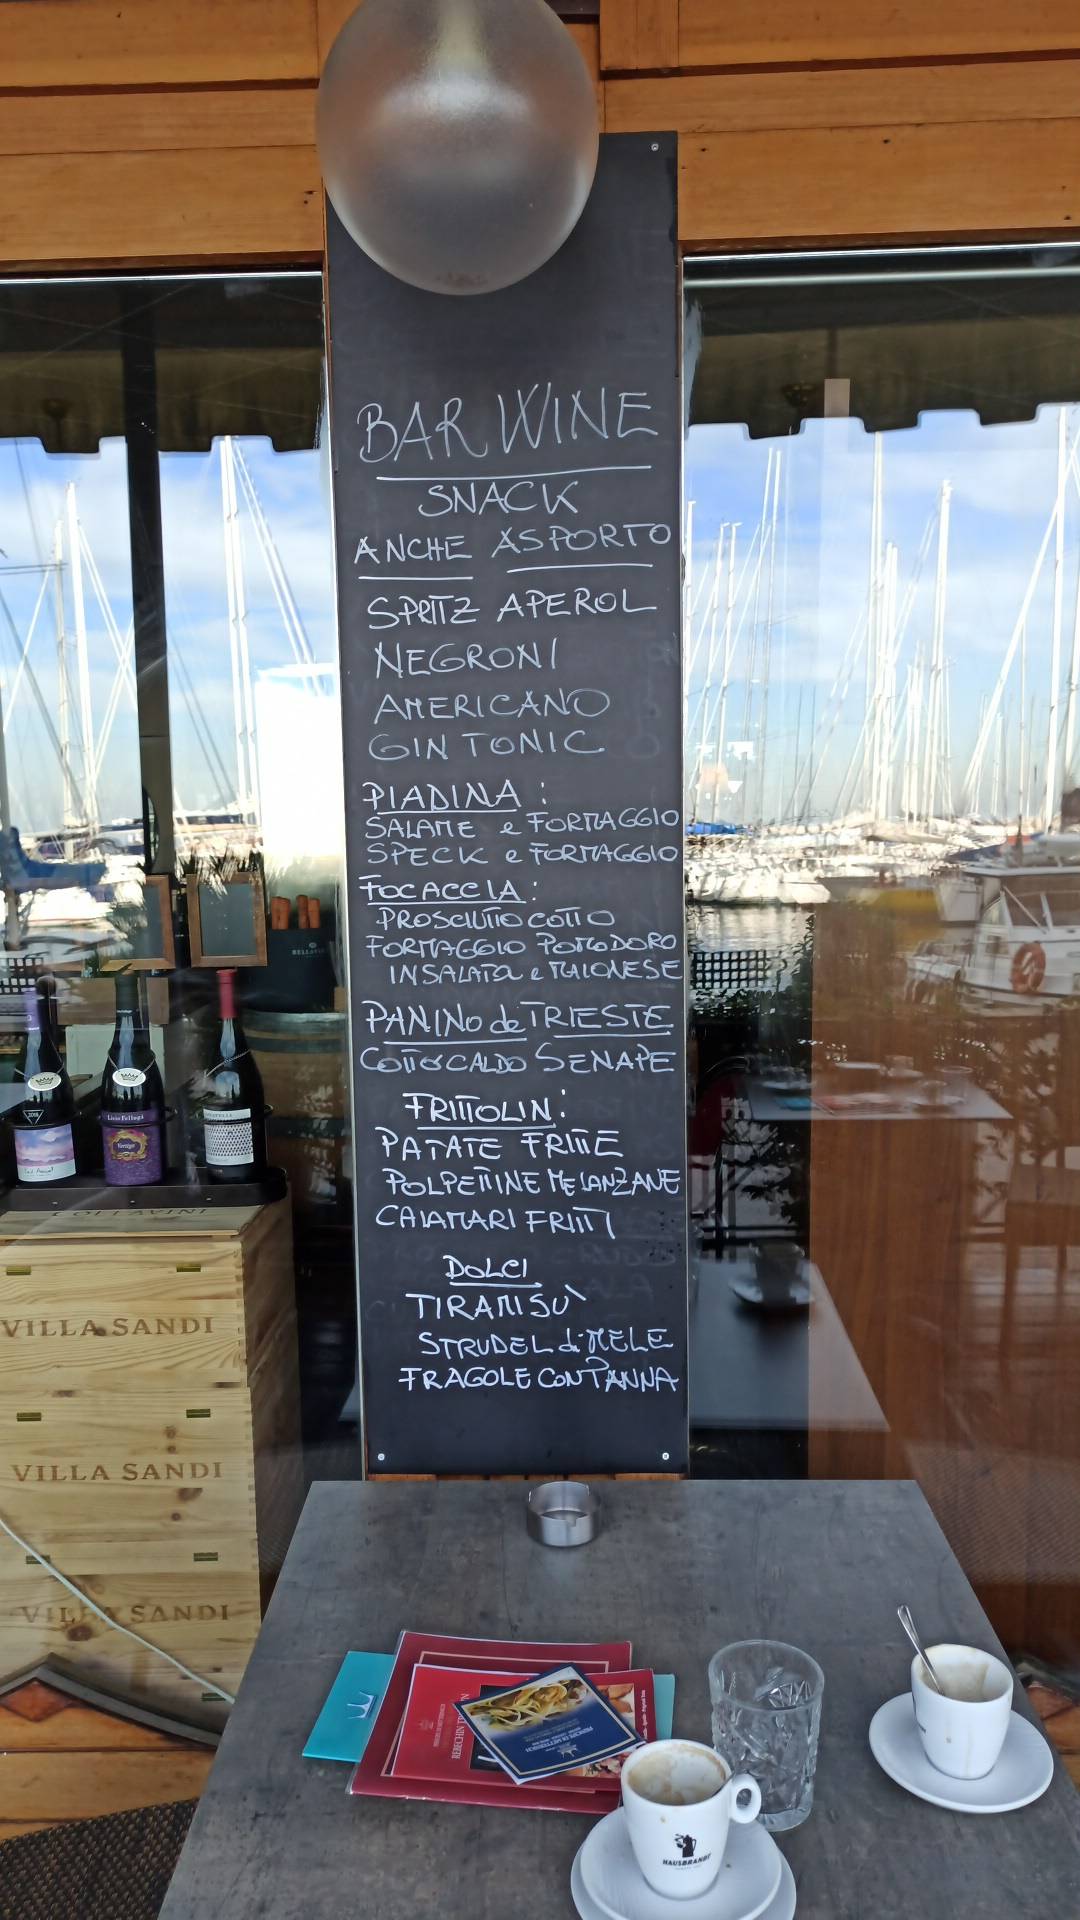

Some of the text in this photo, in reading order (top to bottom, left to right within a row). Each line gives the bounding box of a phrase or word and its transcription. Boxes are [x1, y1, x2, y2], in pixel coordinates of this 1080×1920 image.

[358, 382, 658, 463] BAR WINE
[418, 481, 579, 517] SNACK
[354, 523, 671, 564] ANCHE ASPORTO
[367, 587, 657, 630] SPRITZ APEROL
[374, 637, 558, 679] NEGRONI
[373, 687, 610, 724] AMERICANO
[368, 728, 606, 761] GIN TONIC
[364, 807, 680, 839] SALAME e FORMAGGIO
[367, 841, 678, 867] SPECK e FORMAGGIO
[376, 906, 615, 931] PROSCIUTTO COTTO
[365, 935, 526, 959] FORMAGGIO
[549, 959, 683, 981] MAIONESE
[519, 1001, 675, 1030] TRIESTE
[534, 1042, 677, 1073] SENAPE
[374, 1126, 624, 1161] PATATE FRITTE
[381, 1166, 681, 1196] POLPETTINE MELANZANE
[375, 1204, 616, 1240] CALAMARI FRITTI
[442, 1254, 528, 1280] DOLCI
[1, 1317, 215, 1338] VILLA SANDI
[418, 1331, 553, 1360] STRUDEL
[585, 1326, 674, 1354] MELE
[398, 1366, 532, 1392] FRAGOLE
[582, 1356, 681, 1393] PANNA
[11, 1461, 224, 1482] VILLA SANDI
[130, 1604, 230, 1623] SANDI
[662, 1852, 712, 1866] HAUSBRANDT
